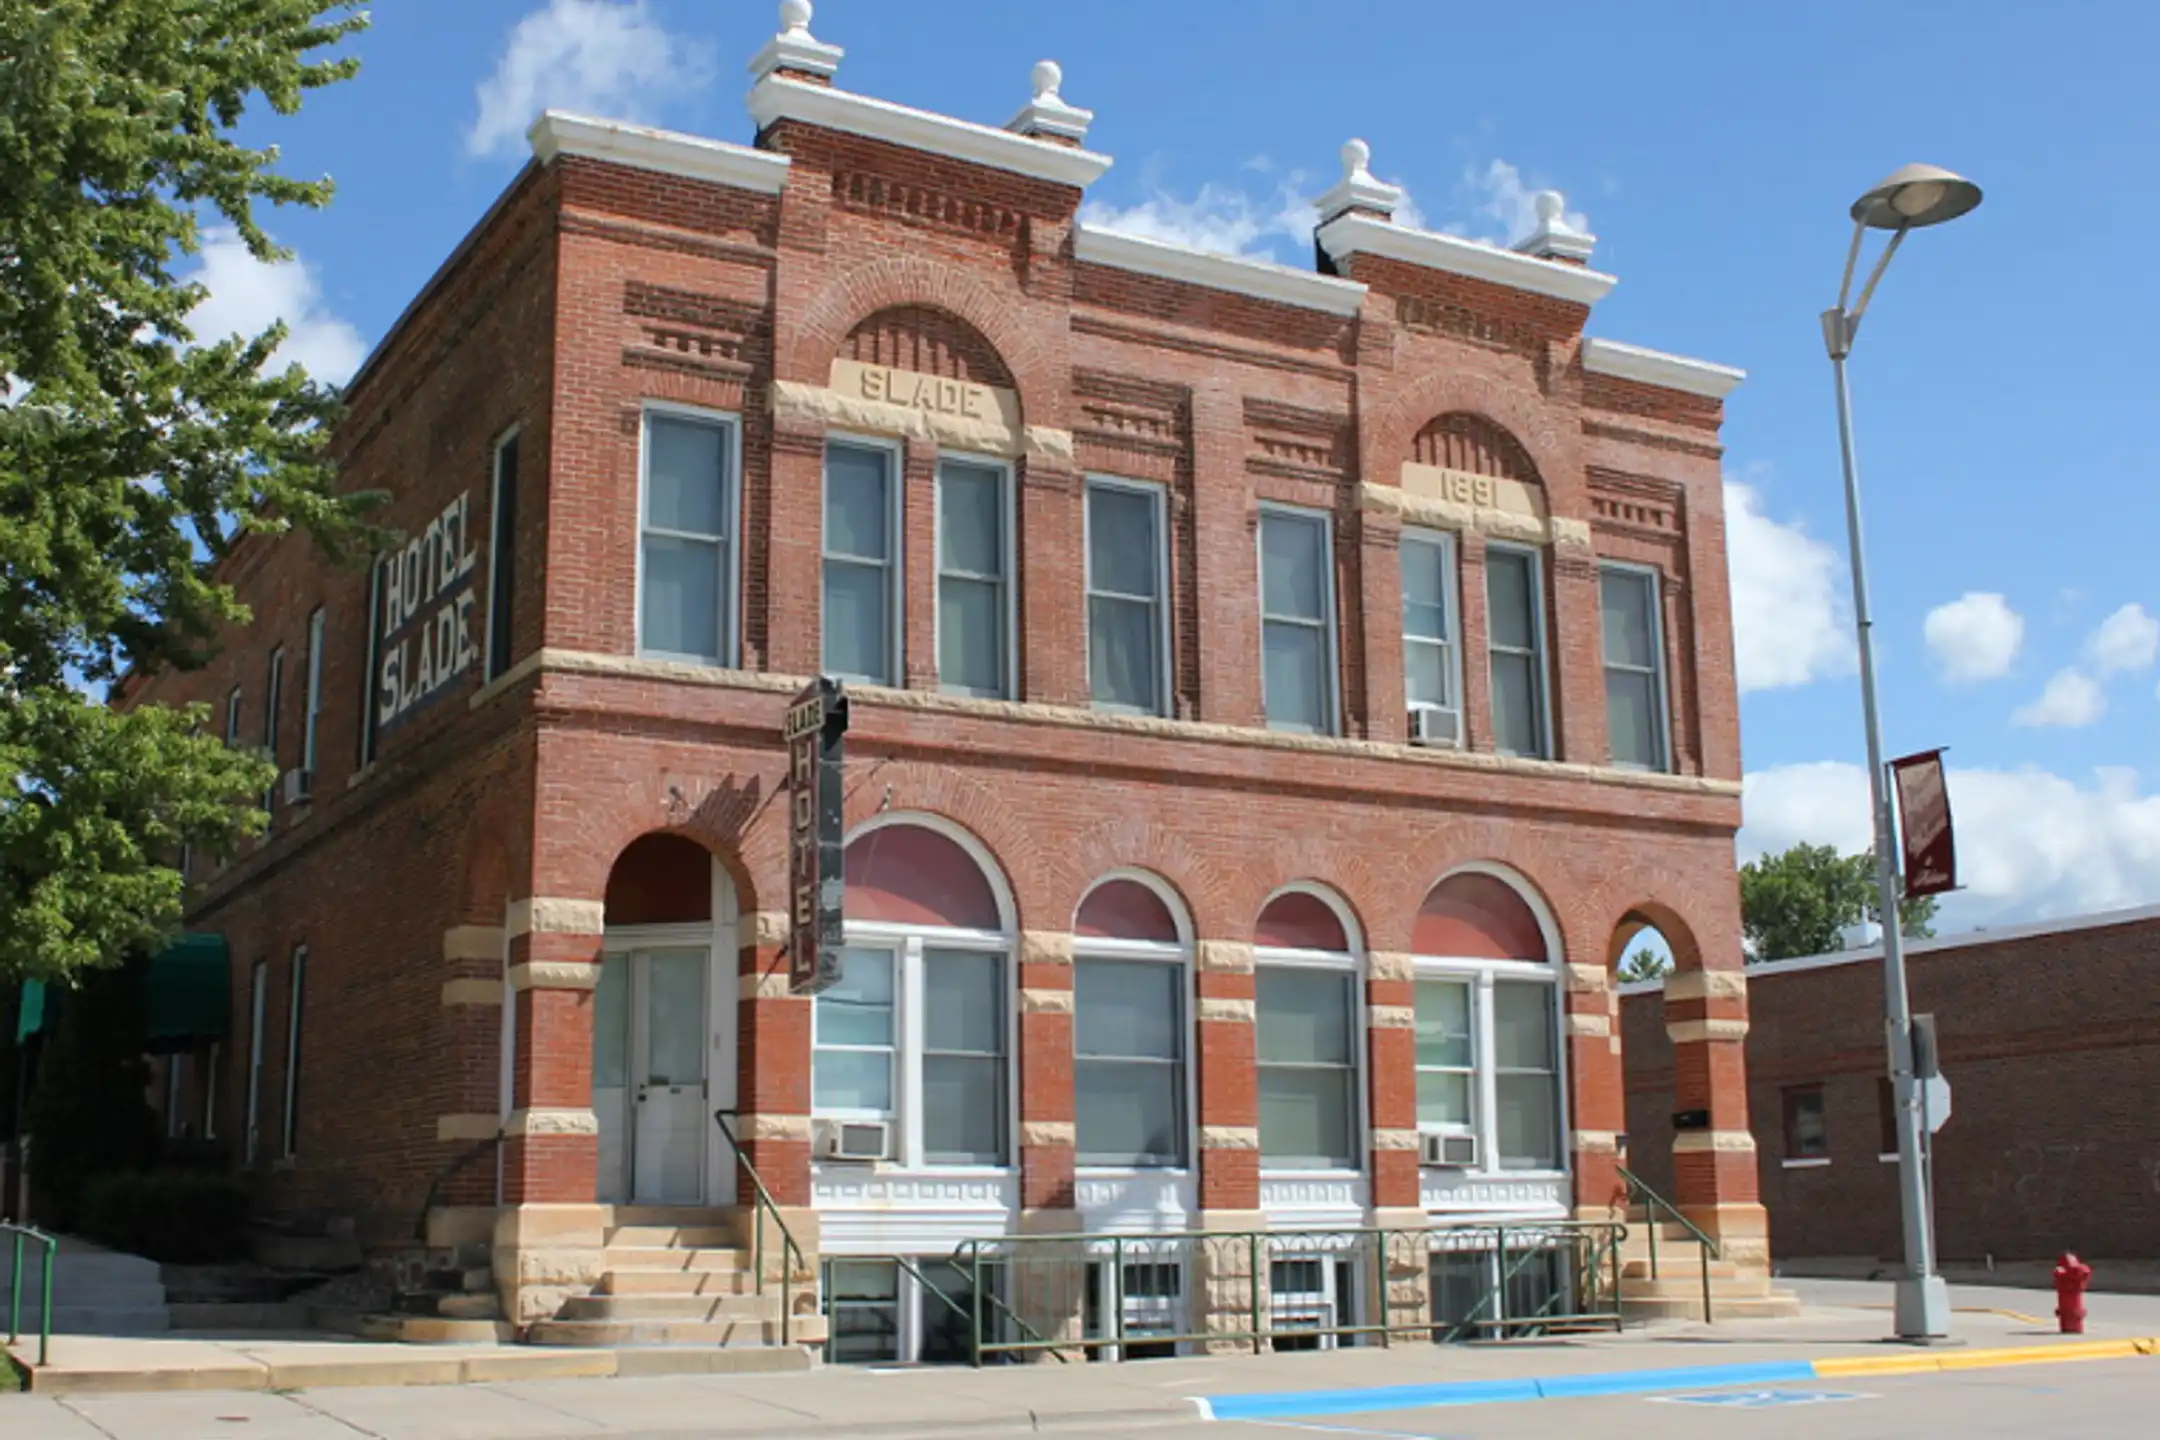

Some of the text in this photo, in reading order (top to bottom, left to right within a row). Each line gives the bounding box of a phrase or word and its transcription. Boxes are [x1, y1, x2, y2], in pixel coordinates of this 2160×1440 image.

[861, 368, 982, 419] SLADE
[1440, 471, 1498, 508] 1891
[385, 489, 478, 639] HOTEL
[380, 588, 479, 726] SLADE
[787, 700, 820, 736] SLADE
[794, 740, 813, 974] HOTEL
